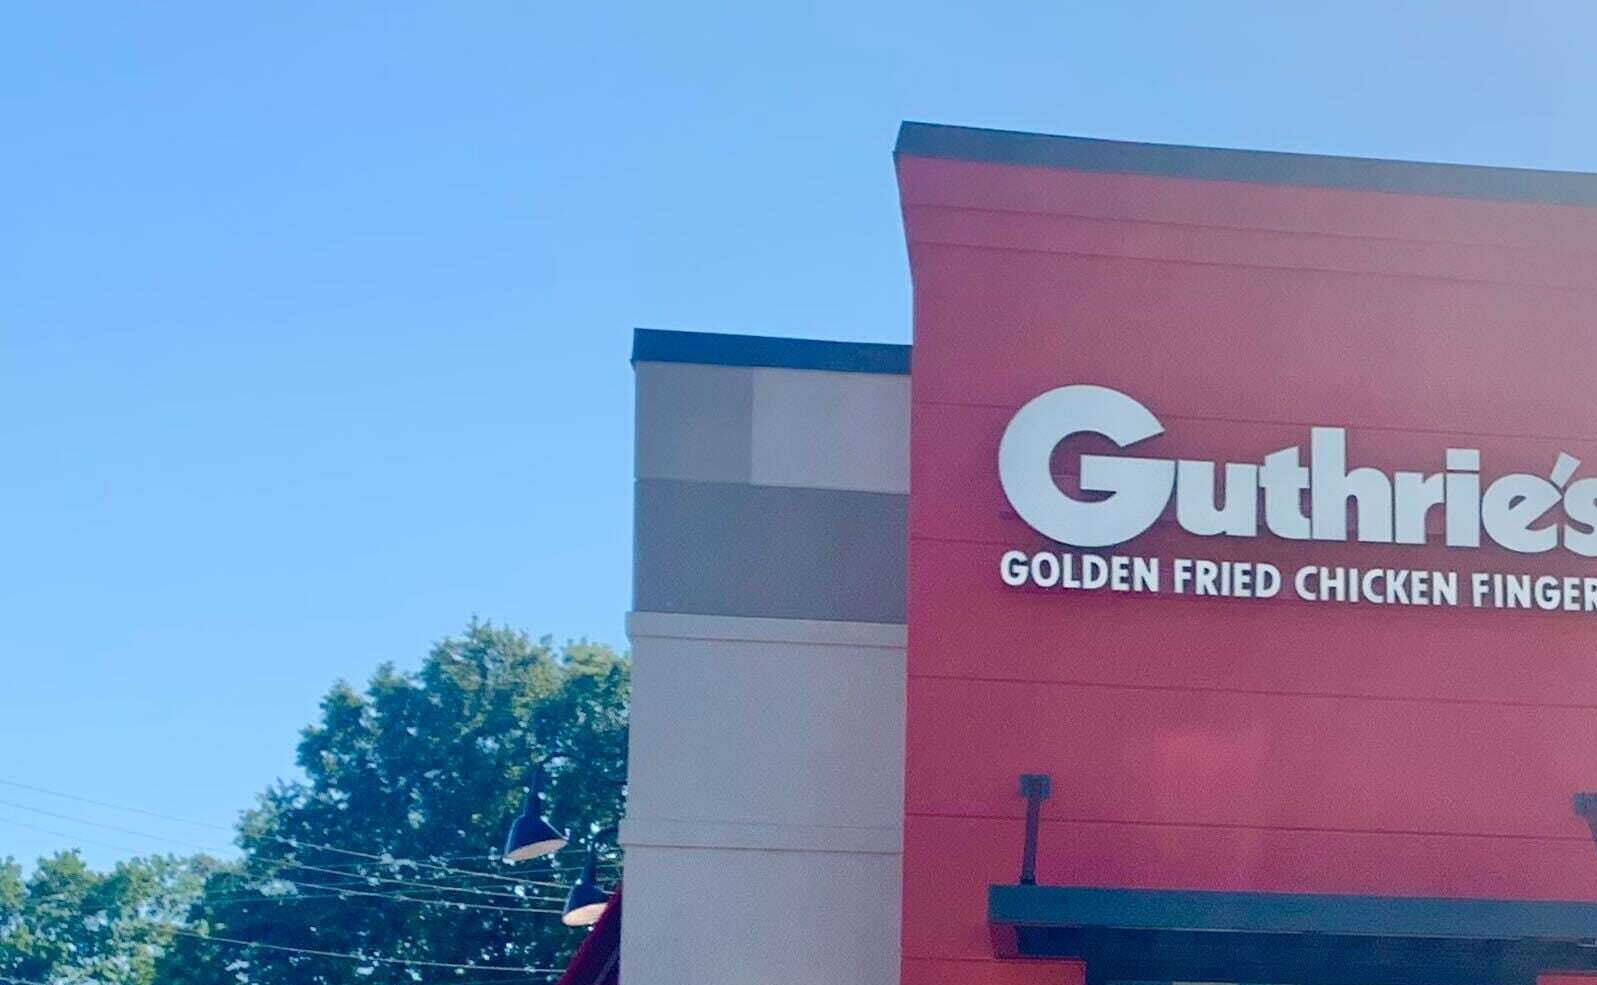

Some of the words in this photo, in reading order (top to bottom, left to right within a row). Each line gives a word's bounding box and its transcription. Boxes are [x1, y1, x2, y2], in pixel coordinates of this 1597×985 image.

[1000, 550, 1159, 592] GOLDEN
[1174, 558, 1282, 598] FRIED
[1294, 565, 1457, 606] CHICKEN
